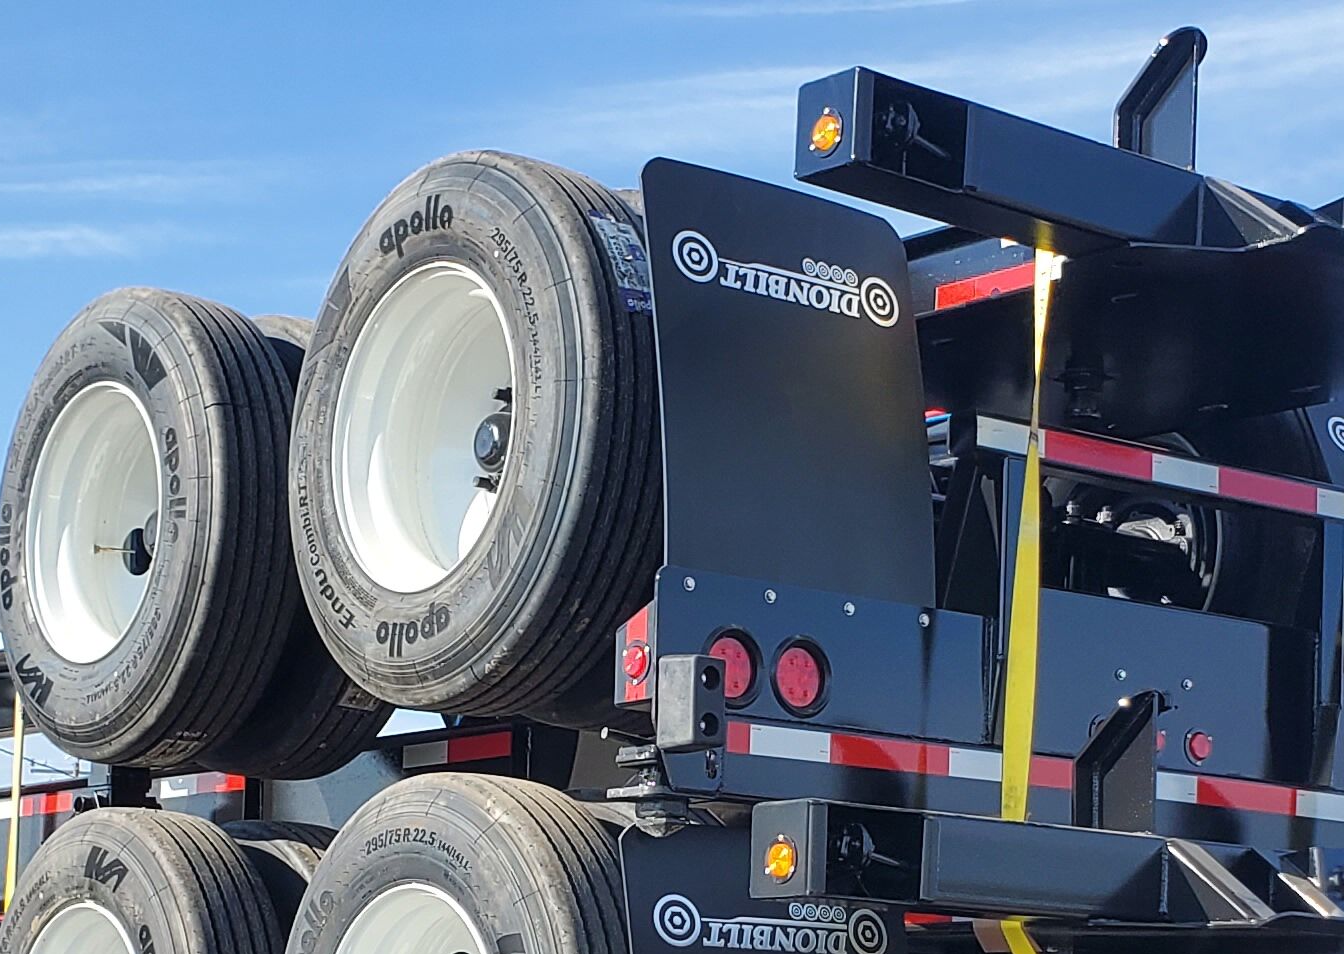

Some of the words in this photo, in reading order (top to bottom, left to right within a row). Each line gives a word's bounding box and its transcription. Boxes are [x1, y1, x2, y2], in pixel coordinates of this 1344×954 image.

[379, 194, 453, 259] apollo
[719, 263, 861, 318] DIONBILT
[164, 427, 187, 543] apollo
[376, 601, 452, 658] apollo
[365, 828, 402, 856] 295/75
